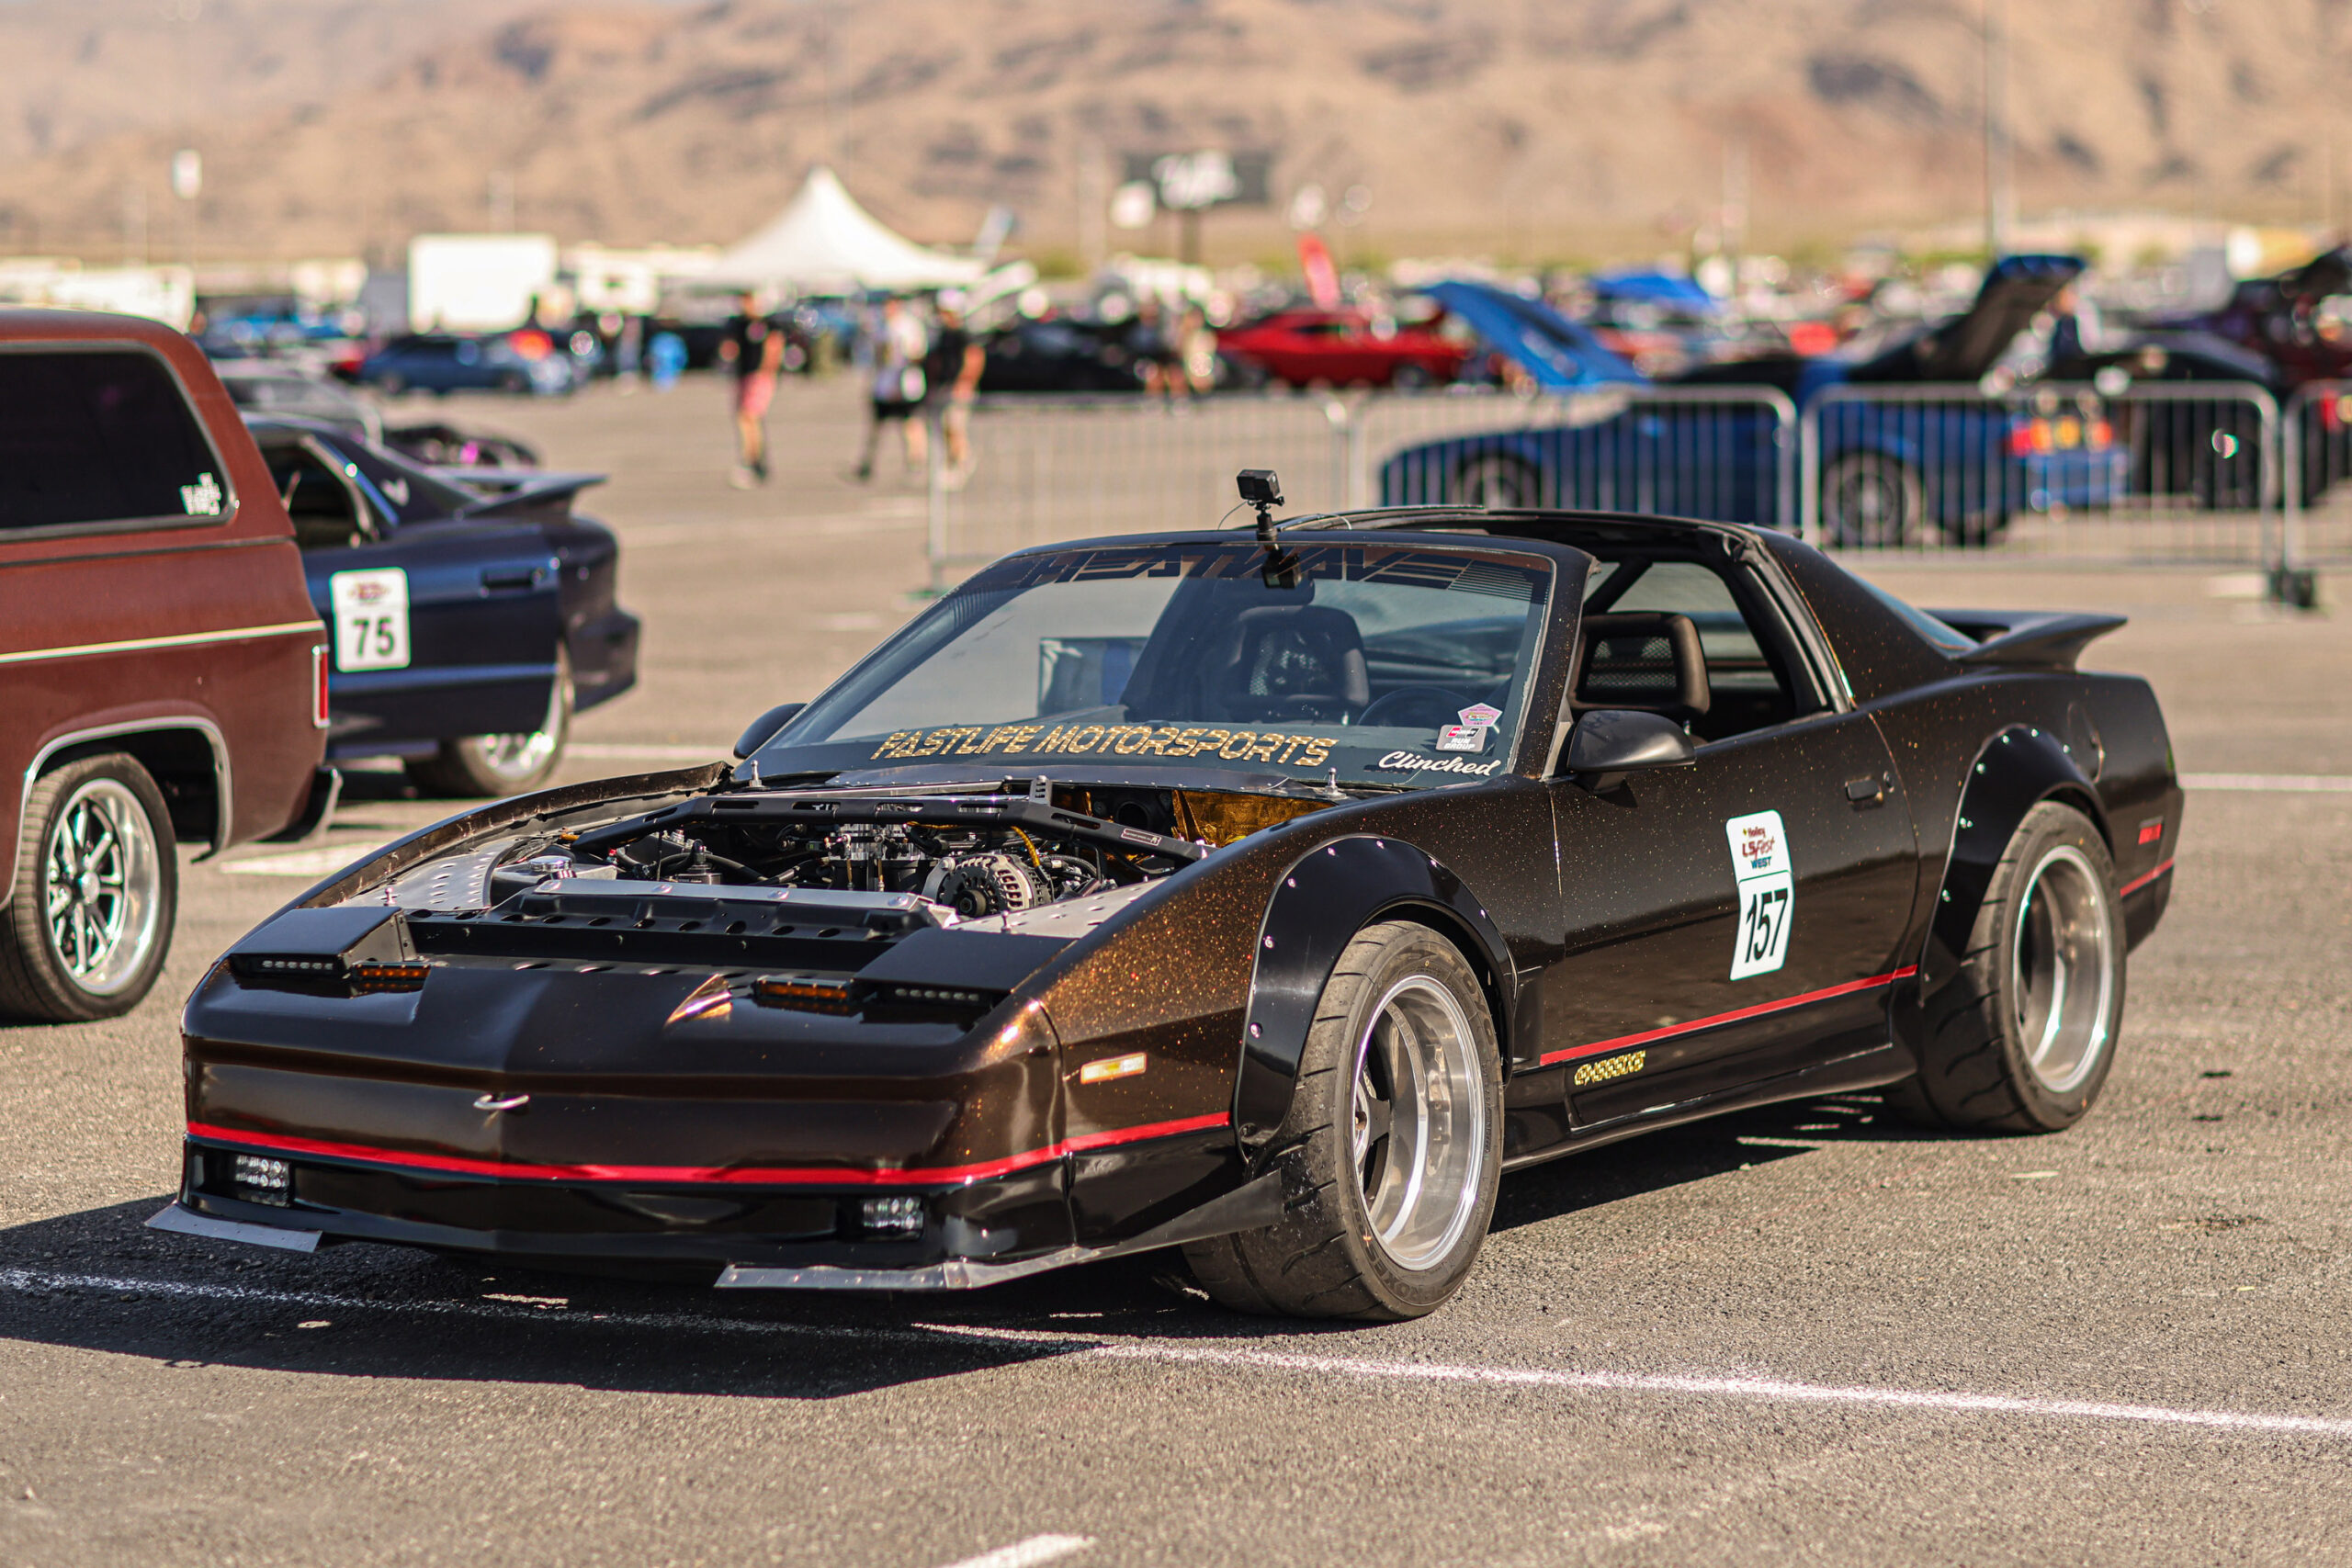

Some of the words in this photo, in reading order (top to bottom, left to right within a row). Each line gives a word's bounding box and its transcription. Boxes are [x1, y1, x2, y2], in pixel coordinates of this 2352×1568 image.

[352, 616, 394, 658] 75
[869, 724, 1046, 761] FASTLIFE
[1031, 724, 1340, 767] MOTORSPORTS
[1378, 750, 1502, 777] Clinched
[1750, 856, 1772, 870] WEST
[1745, 887, 1788, 963] 157
